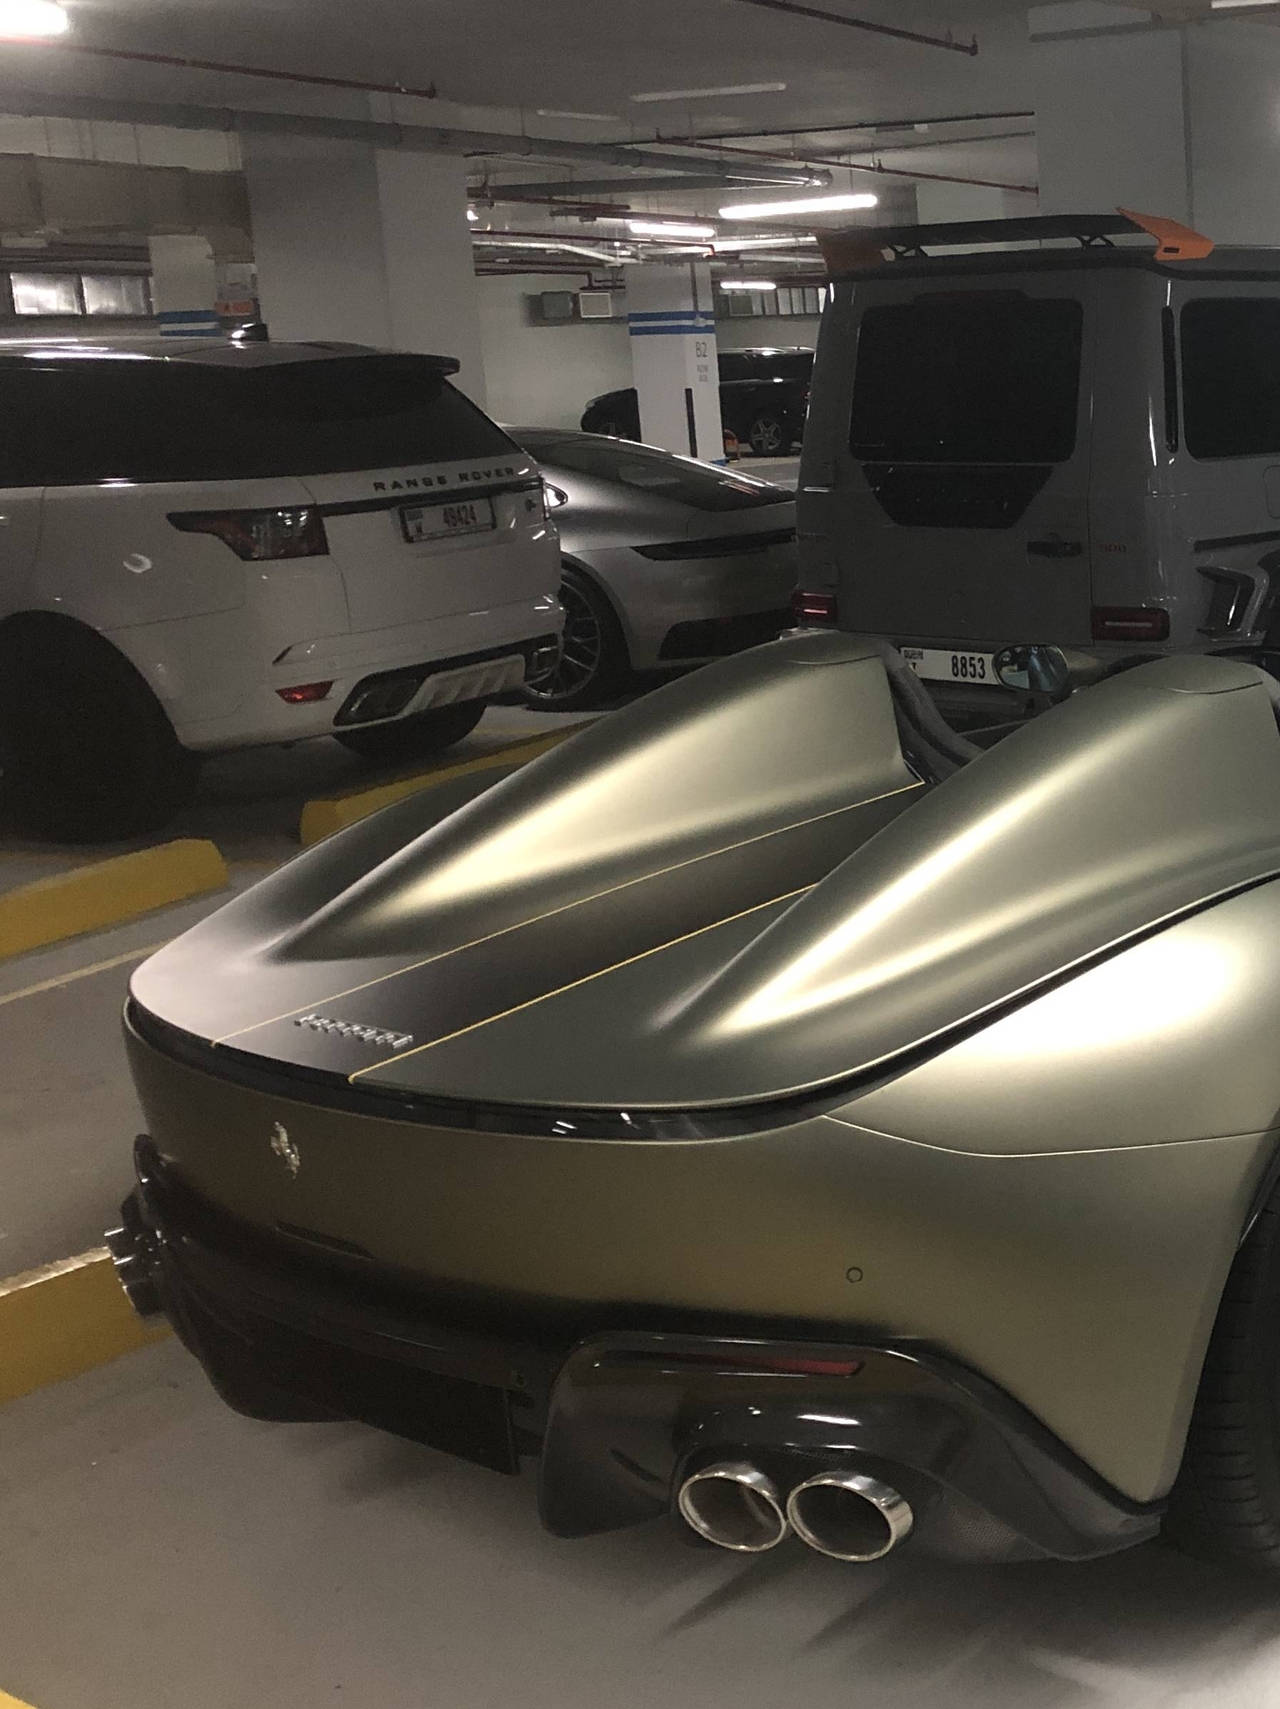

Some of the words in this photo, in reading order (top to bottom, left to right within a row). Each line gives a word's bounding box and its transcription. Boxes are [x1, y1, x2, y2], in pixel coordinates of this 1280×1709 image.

[695, 341, 708, 358] B2
[373, 475, 448, 492] RANGE
[458, 467, 514, 482] ROVER
[951, 654, 986, 680] 8853
